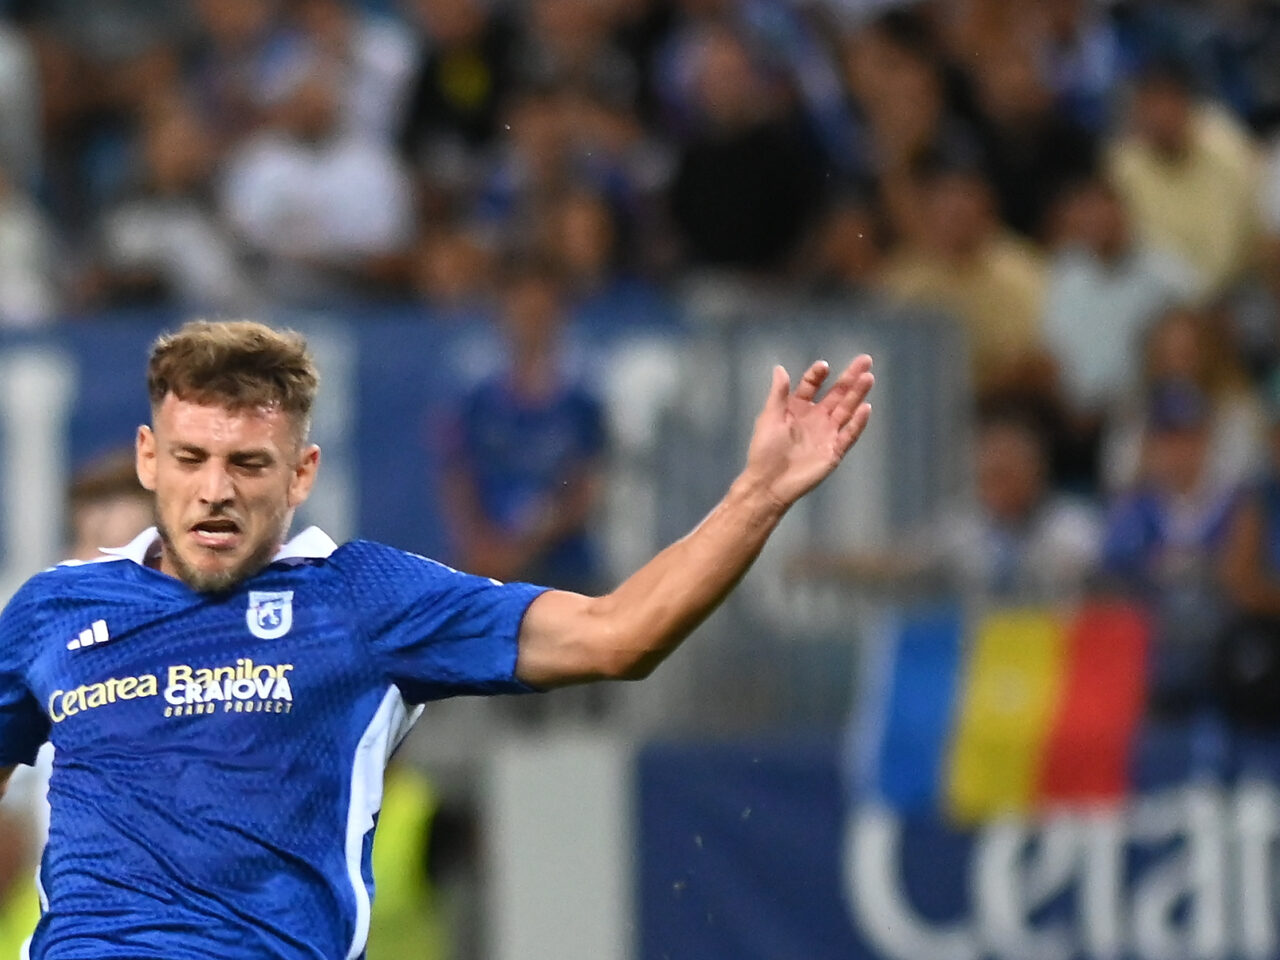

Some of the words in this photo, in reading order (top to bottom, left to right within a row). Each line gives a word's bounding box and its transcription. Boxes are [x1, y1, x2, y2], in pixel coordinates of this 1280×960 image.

[48, 674, 158, 723] Cetatea
[163, 676, 293, 705] CRAIOVA
[164, 702, 216, 717] GRAND
[224, 701, 294, 714] PROJECT
